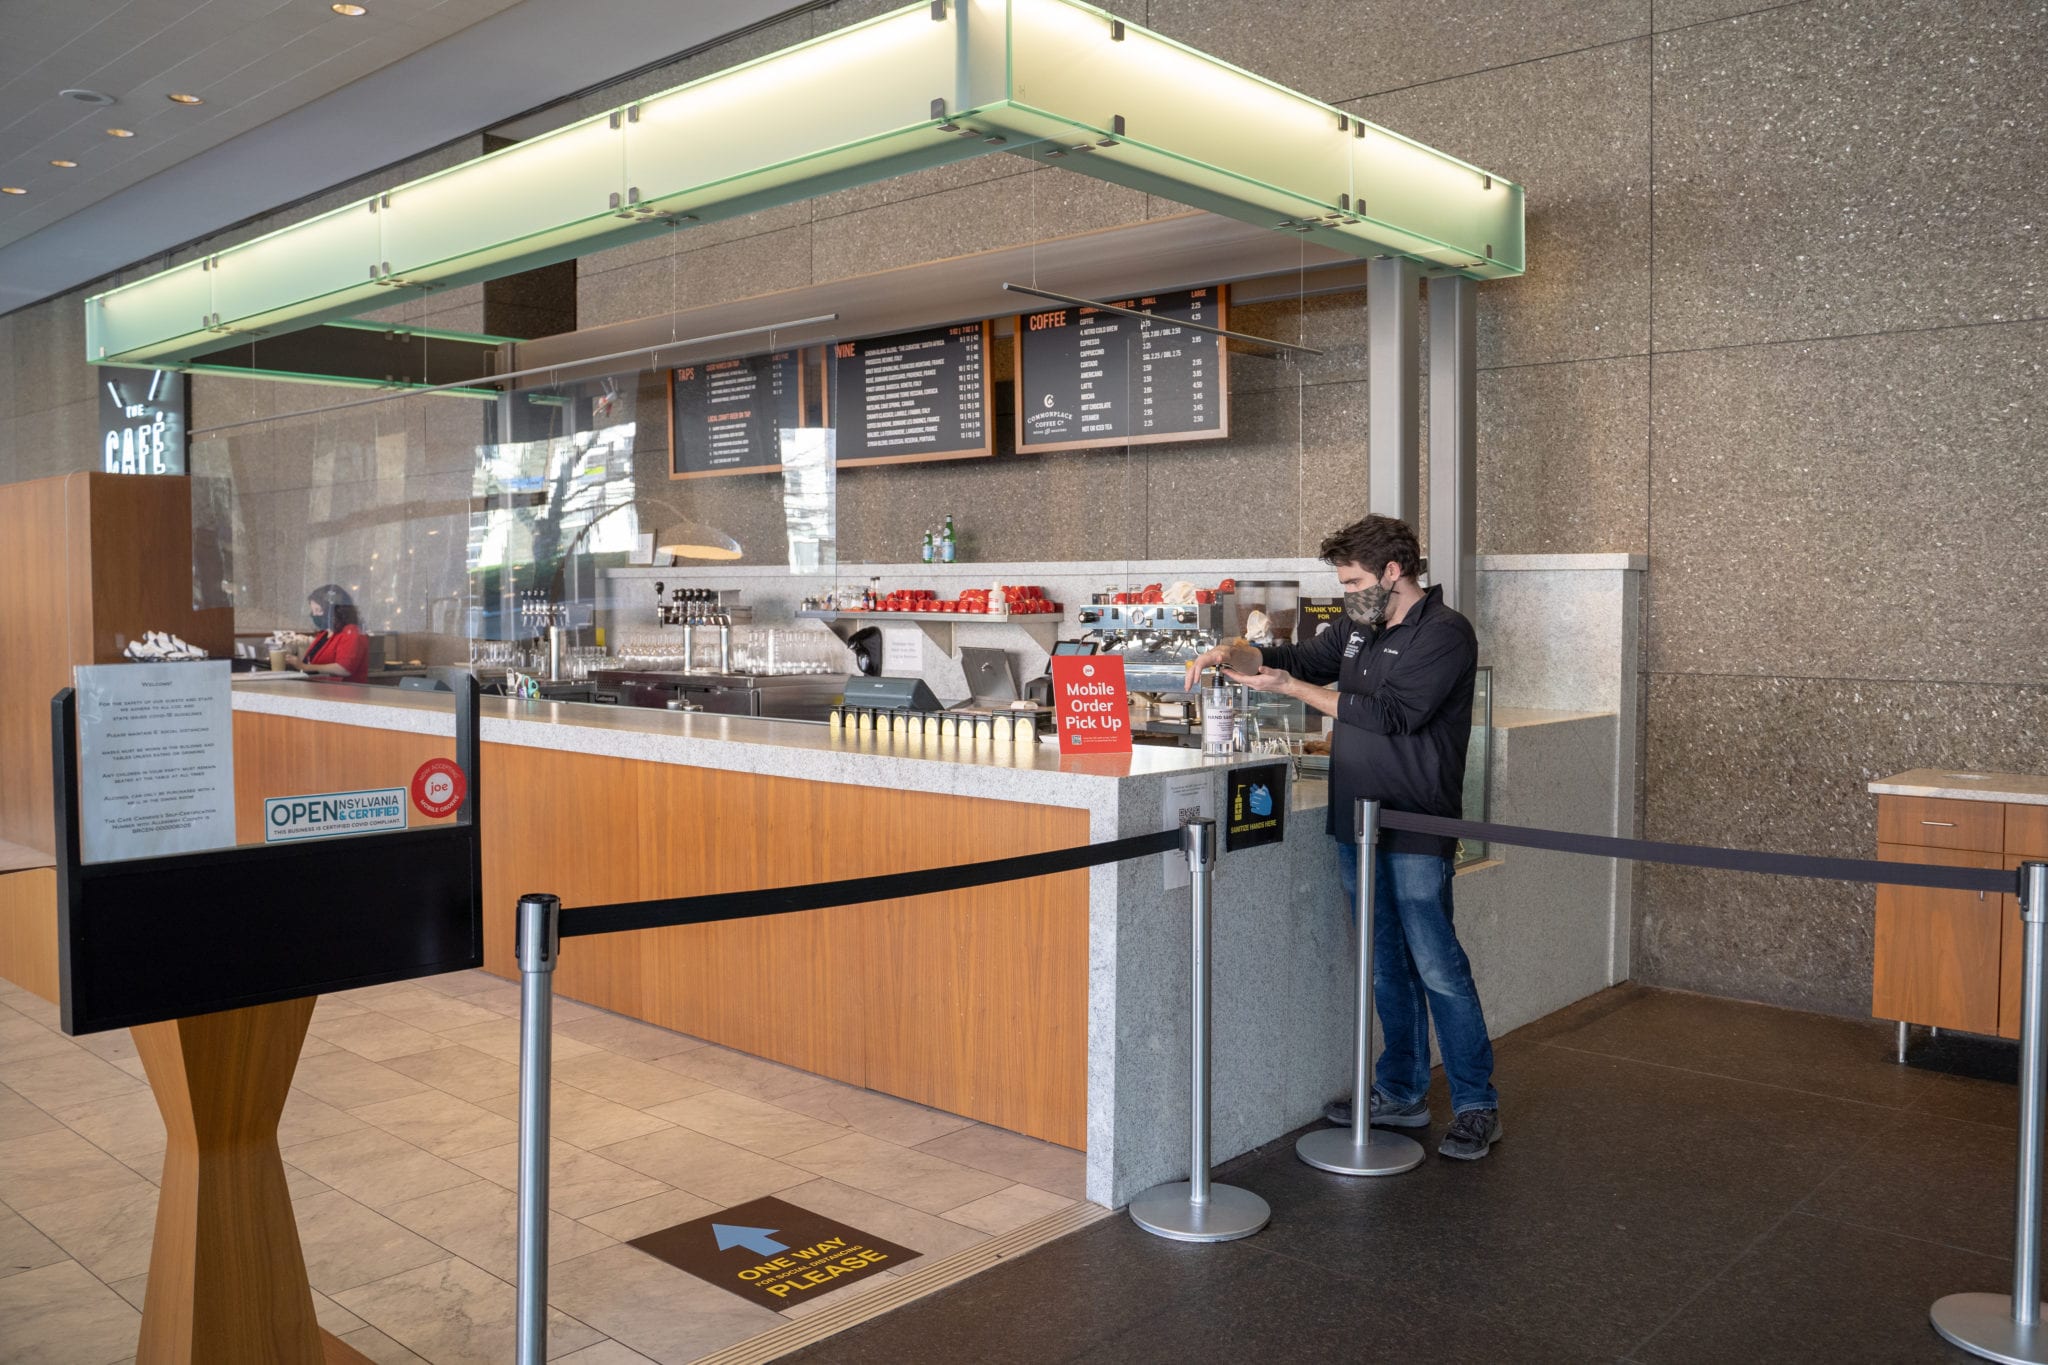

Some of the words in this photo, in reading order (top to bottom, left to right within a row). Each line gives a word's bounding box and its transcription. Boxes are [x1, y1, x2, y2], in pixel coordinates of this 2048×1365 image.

[1191, 289, 1206, 298] LARGE
[1030, 310, 1066, 332] COFFEE
[835, 343, 856, 359] WINE
[678, 367, 694, 382] TAPS
[126, 404, 144, 418] THE
[1027, 411, 1072, 424] COMMONPLACE
[1066, 682, 1114, 696] Mobile
[1071, 699, 1113, 712] Order
[1066, 716, 1097, 729] Pick
[1101, 716, 1122, 731] Up
[419, 768, 430, 780] NOW
[430, 782, 448, 795] joe
[420, 800, 438, 812] MOBILE
[440, 795, 459, 812] ORDERS
[340, 811, 347, 820] &
[348, 806, 399, 820] CERTIFIED
[1231, 824, 1249, 834] SANITIZE
[1250, 822, 1264, 830] HANDS
[737, 1257, 797, 1280] ONE
[790, 1237, 847, 1260] WAY
[755, 1277, 776, 1287] FOR
[776, 1264, 811, 1279] SOCIAL
[810, 1245, 863, 1268] DISTANCING
[766, 1249, 889, 1298] PLEASE
